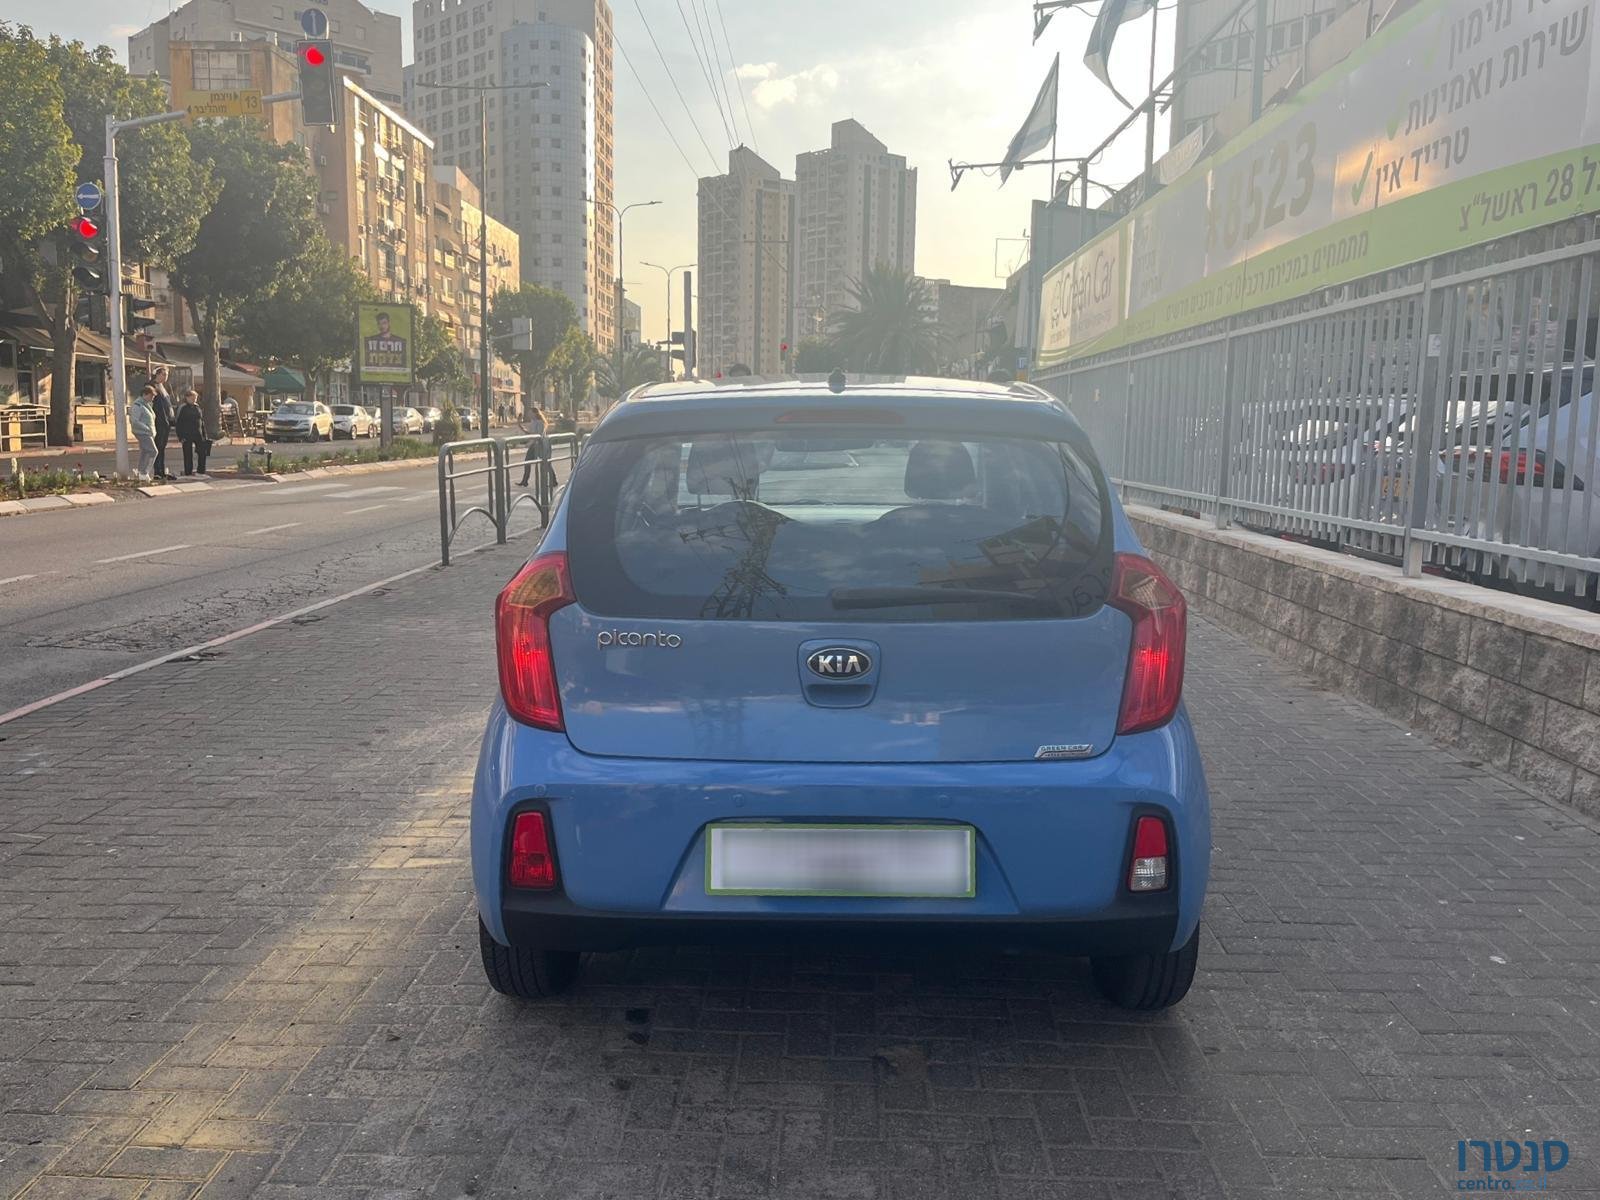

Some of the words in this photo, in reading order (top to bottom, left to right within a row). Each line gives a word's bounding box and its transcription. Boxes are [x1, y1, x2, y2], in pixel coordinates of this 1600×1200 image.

[1449, 0, 1512, 71] מימון
[1500, 5, 1589, 88] שירות
[209, 92, 232, 104] ויצמן
[244, 95, 258, 109] 13
[1405, 57, 1493, 136] ואמינות
[1411, 126, 1470, 182] טרייד
[1374, 155, 1405, 208] אין
[1544, 163, 1575, 207] 28
[1265, 253, 1309, 291] במכירת
[1312, 230, 1369, 274] מתמחים
[1094, 250, 1116, 303] Car
[379, 341, 403, 352] חרם
[597, 628, 682, 649] picanto
[818, 655, 862, 673] KIA
